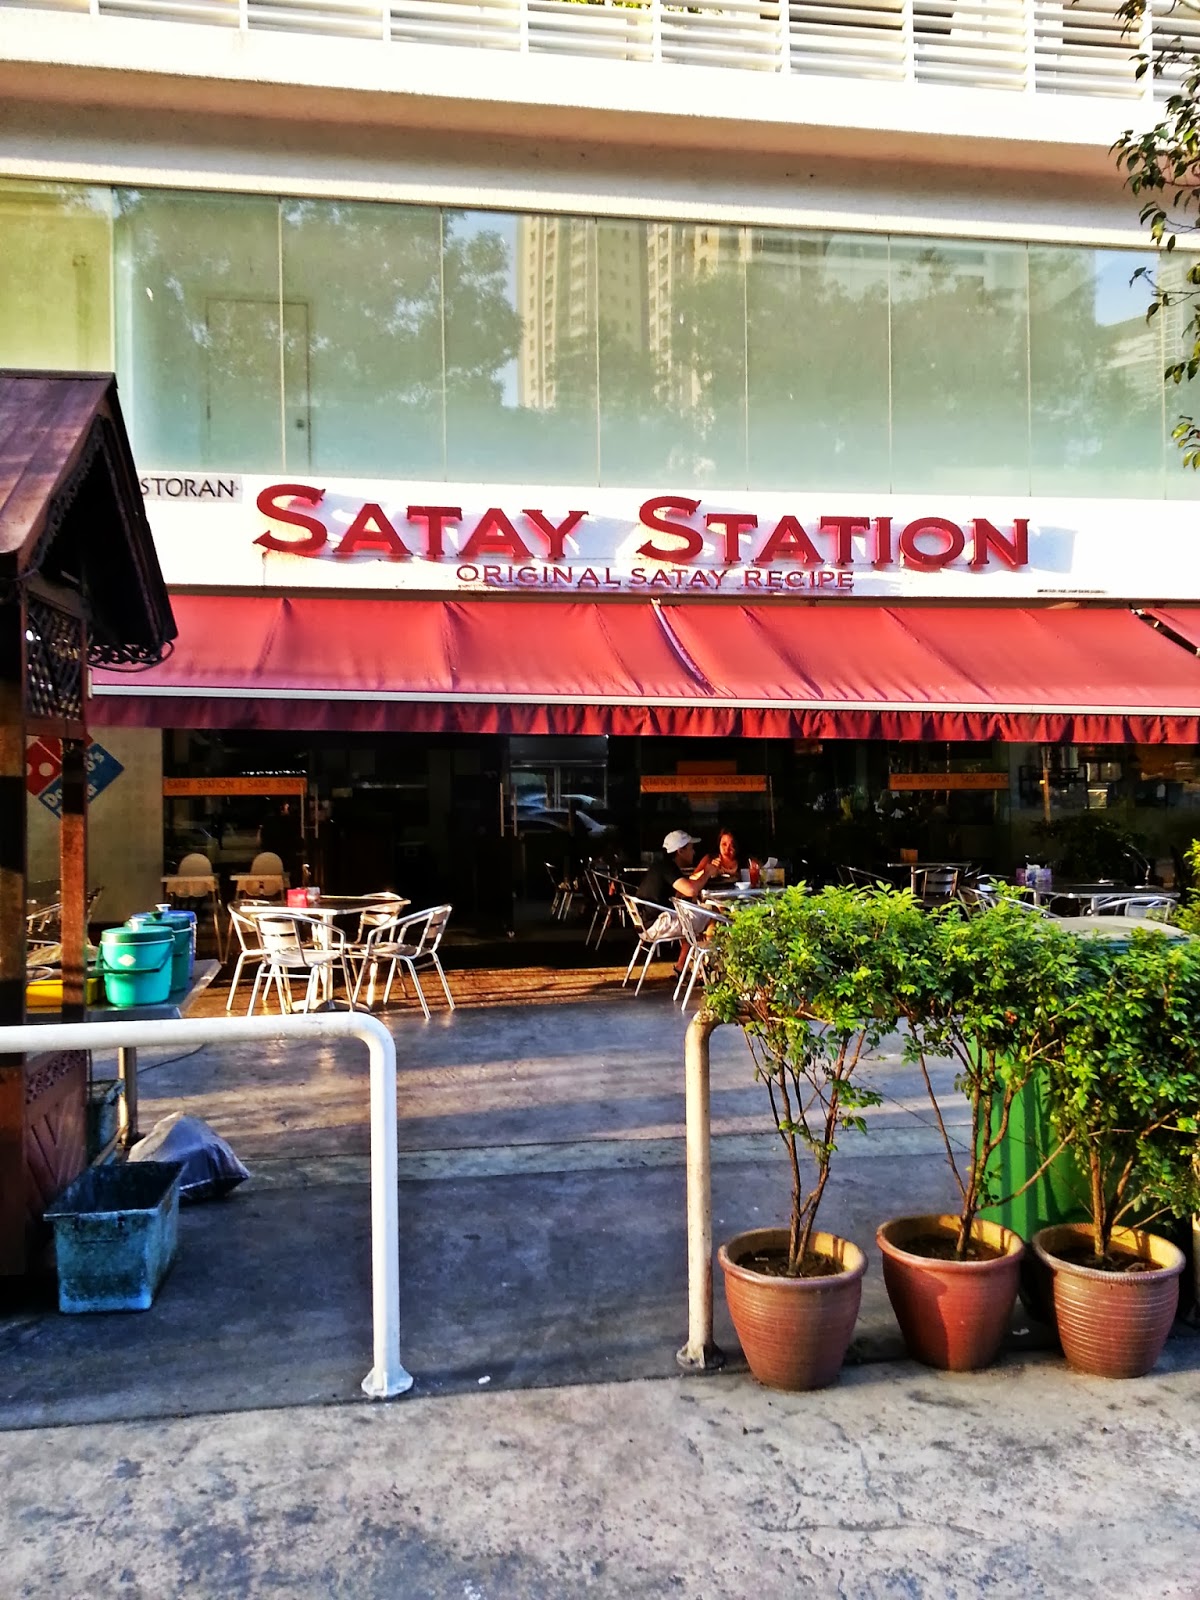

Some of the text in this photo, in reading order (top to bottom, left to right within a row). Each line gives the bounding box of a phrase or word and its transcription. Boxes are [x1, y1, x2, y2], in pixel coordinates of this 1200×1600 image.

[253, 483, 1030, 572] SATAY STATION
[456, 564, 854, 590] ORIGINAL SATAY RECIPE
